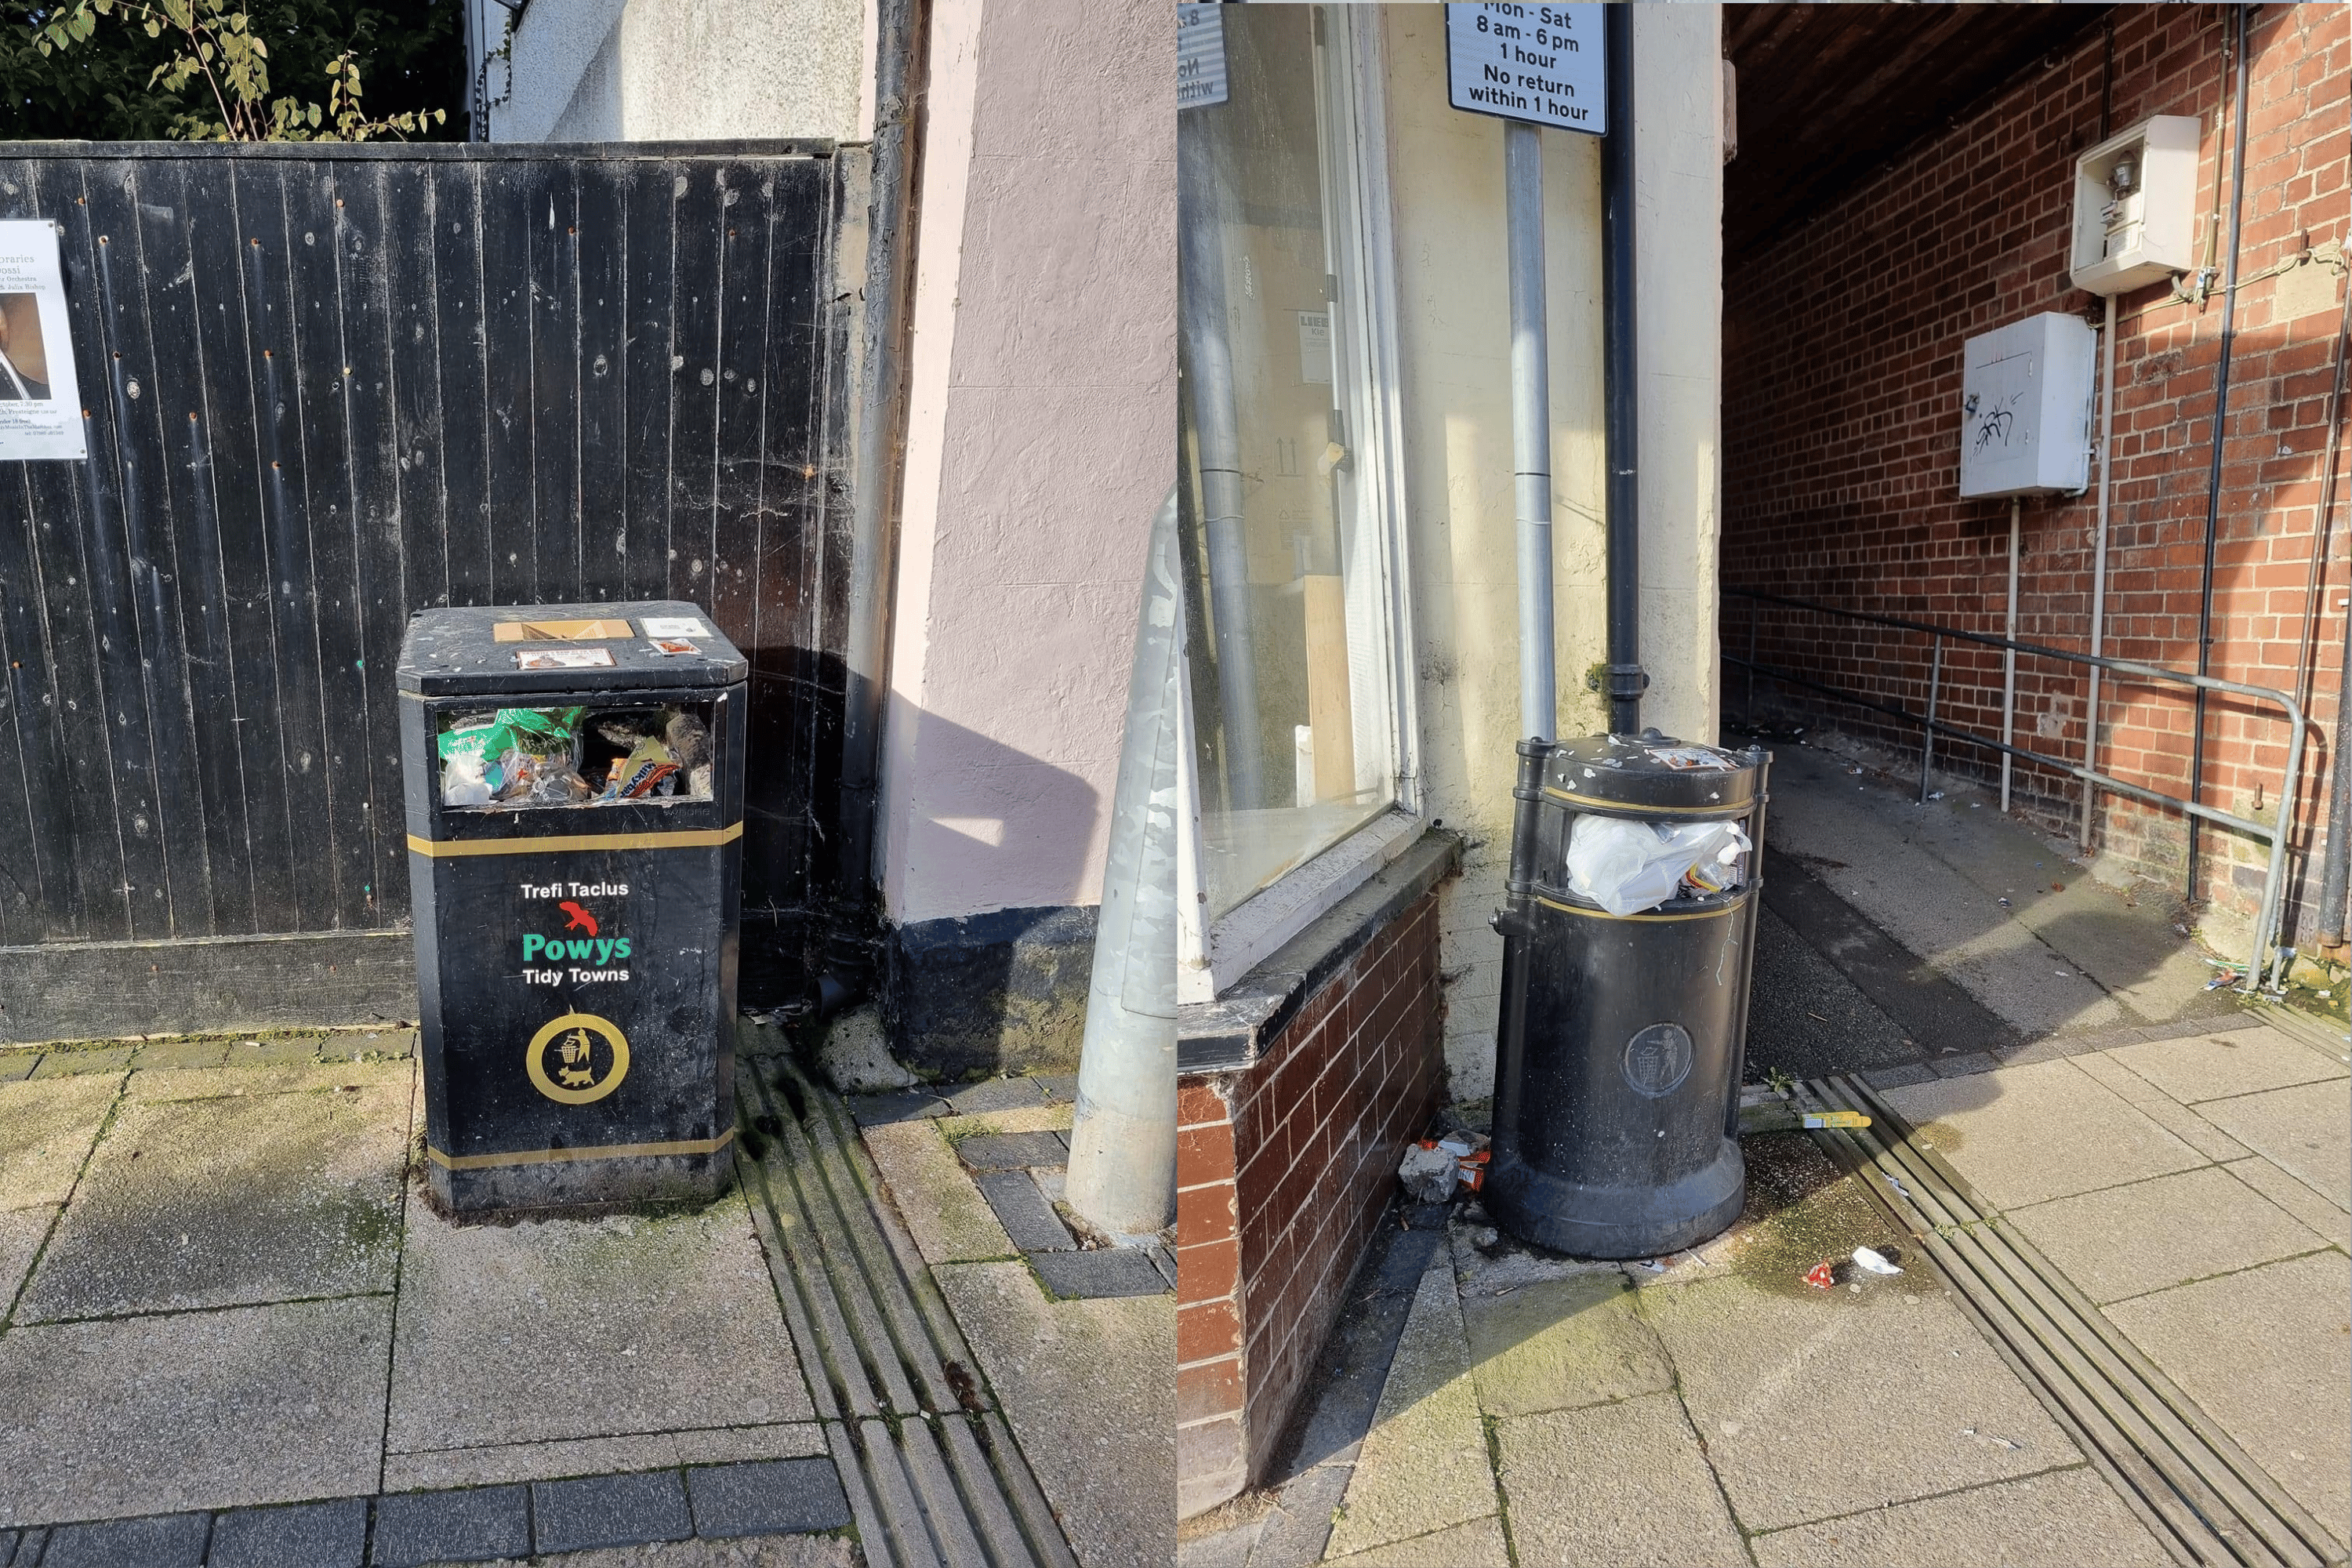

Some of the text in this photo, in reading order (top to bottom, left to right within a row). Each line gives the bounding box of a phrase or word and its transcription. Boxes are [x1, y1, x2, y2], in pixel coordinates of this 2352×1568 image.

[1540, 7, 1572, 29] Sat
[1477, 15, 1488, 32] 8
[1494, 23, 1520, 39] am
[1537, 28, 1548, 45] 6
[1552, 35, 1579, 53] pm
[1501, 42, 1556, 69] 1 hour
[1484, 64, 1574, 97] No return
[1468, 86, 1589, 121] within 1 hour
[521, 881, 630, 899] Trefi Taclus
[522, 934, 632, 966] Powys
[523, 967, 630, 987] Tidy Towns
